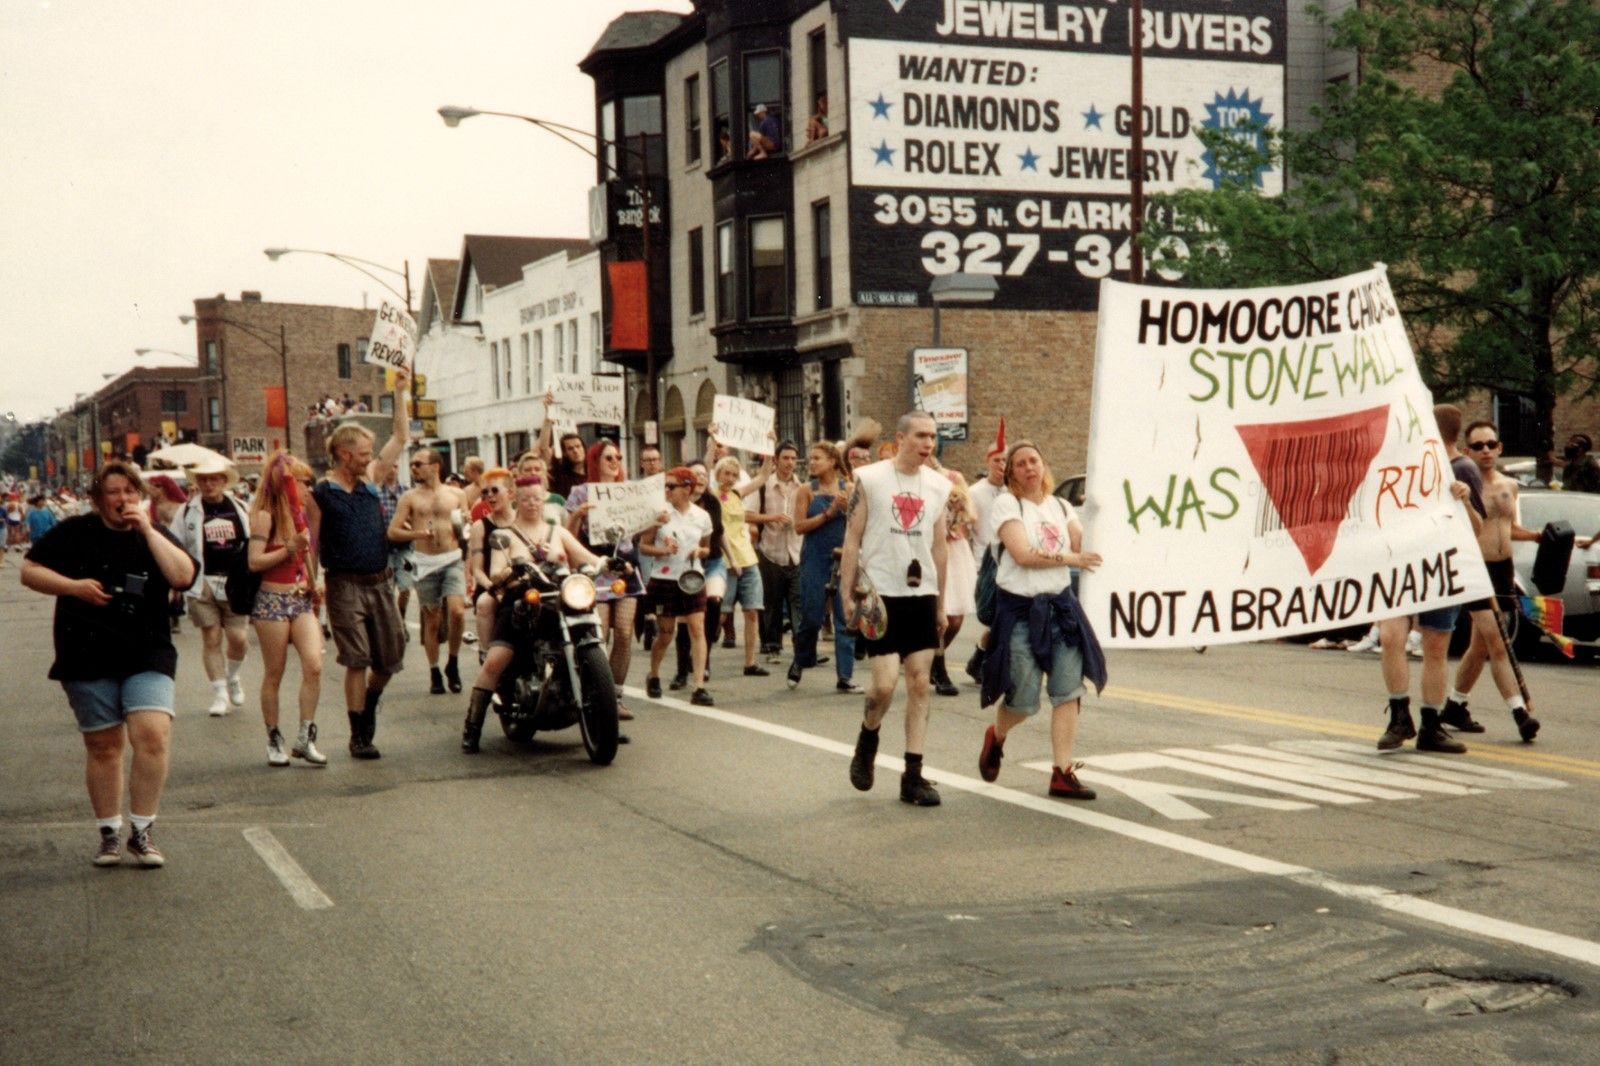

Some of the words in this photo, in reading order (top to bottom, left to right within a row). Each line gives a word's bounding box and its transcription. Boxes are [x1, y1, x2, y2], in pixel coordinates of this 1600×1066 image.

[936, 0, 1108, 43] JEWELRY
[1129, 8, 1273, 55] BUYERS
[899, 54, 1038, 86] WANTED:
[904, 93, 1060, 132] DIAMONDS
[1114, 104, 1190, 139] GOLD
[904, 139, 1002, 176] ROLEX
[1049, 145, 1178, 182] JEWELRY
[617, 206, 661, 227] Bangok
[873, 194, 977, 226] 3055
[987, 207, 1009, 228] N.
[1015, 199, 1133, 230] CLARK
[1138, 291, 1341, 346] HOMOCORE
[1188, 332, 1404, 409] STONEWALL
[1404, 394, 1422, 443] A
[233, 438, 265, 452] PARK
[1122, 466, 1240, 534] WAS
[1376, 438, 1442, 529] RIOT
[1109, 590, 1187, 639] NOT
[1192, 589, 1221, 632] A
